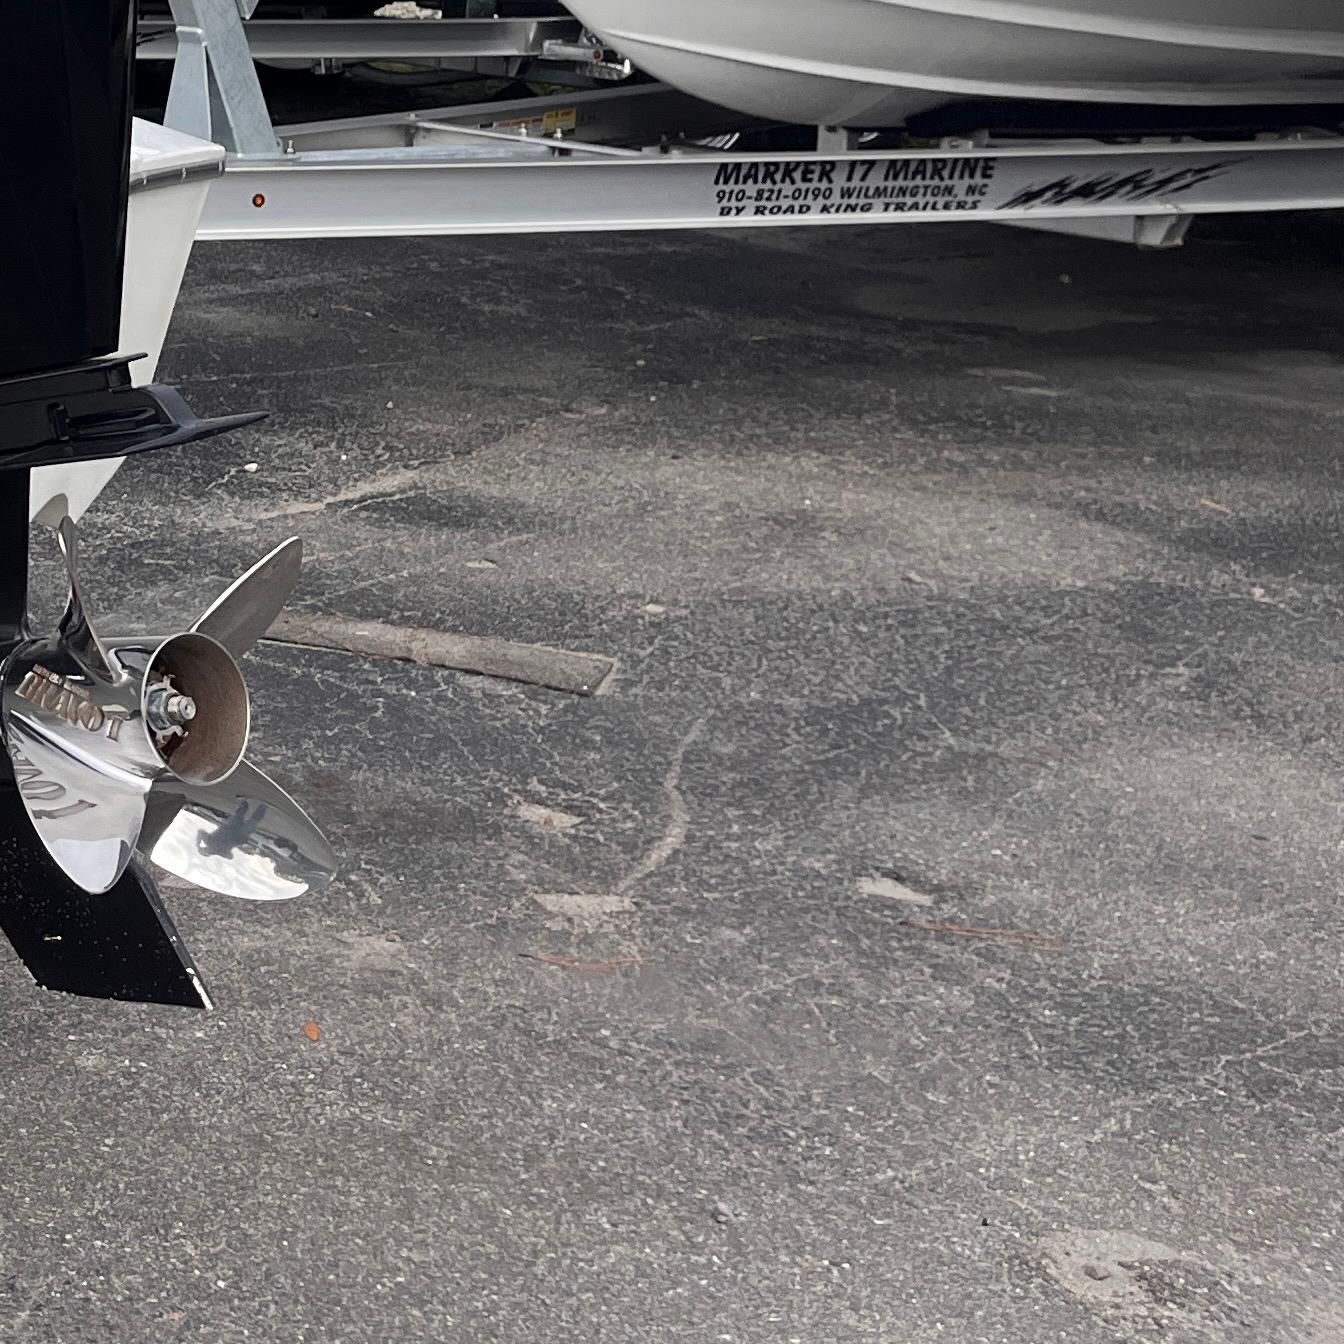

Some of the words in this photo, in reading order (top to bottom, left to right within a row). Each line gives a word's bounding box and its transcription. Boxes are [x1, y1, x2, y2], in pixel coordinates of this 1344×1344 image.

[714, 160, 836, 186] MARKER
[846, 160, 877, 183] 17
[883, 157, 996, 182] MARINE
[716, 187, 832, 204] 910-821-0190
[839, 185, 958, 201] WILMINGTON,
[966, 183, 989, 197] NC
[719, 206, 745, 216] BY
[754, 204, 811, 216] ROAD
[820, 202, 872, 214] KING
[882, 199, 981, 212] TRAILERS
